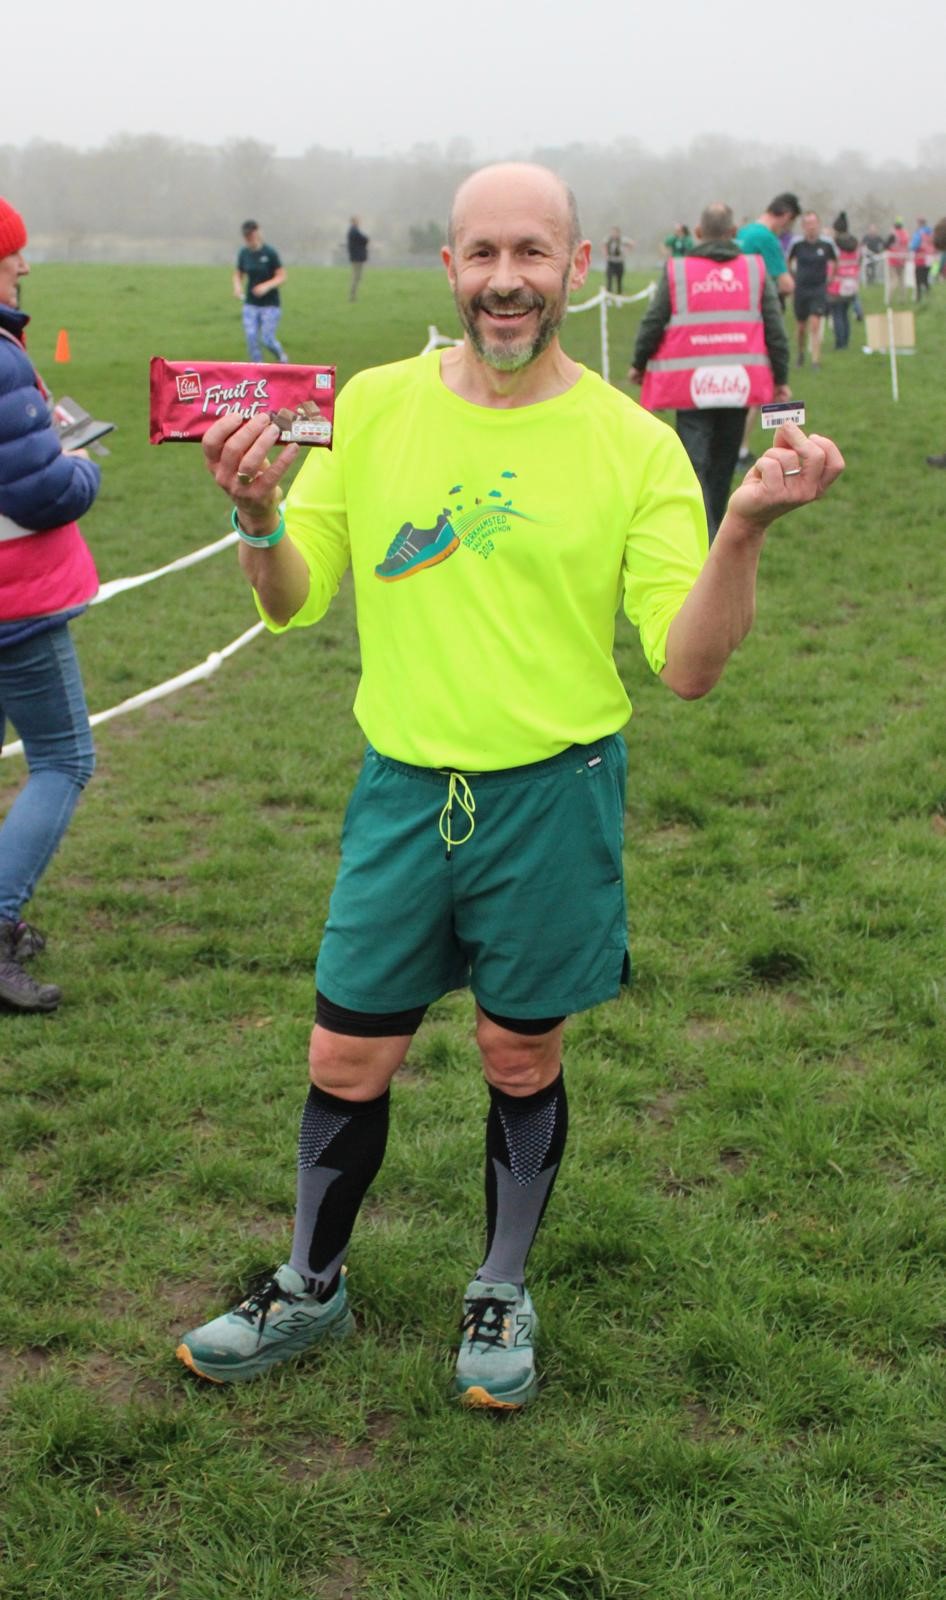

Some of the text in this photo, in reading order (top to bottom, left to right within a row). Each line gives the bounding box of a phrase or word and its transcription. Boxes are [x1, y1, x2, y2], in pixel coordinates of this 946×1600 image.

[691, 277, 743, 296] parkrun
[690, 333, 747, 345] VOLUNTEER
[202, 379, 269, 413] Fruit &
[694, 374, 748, 402] Vitality
[215, 401, 267, 420] Nut
[462, 514, 507, 547] BERKHAMSTED
[478, 539, 495, 560] 2019
